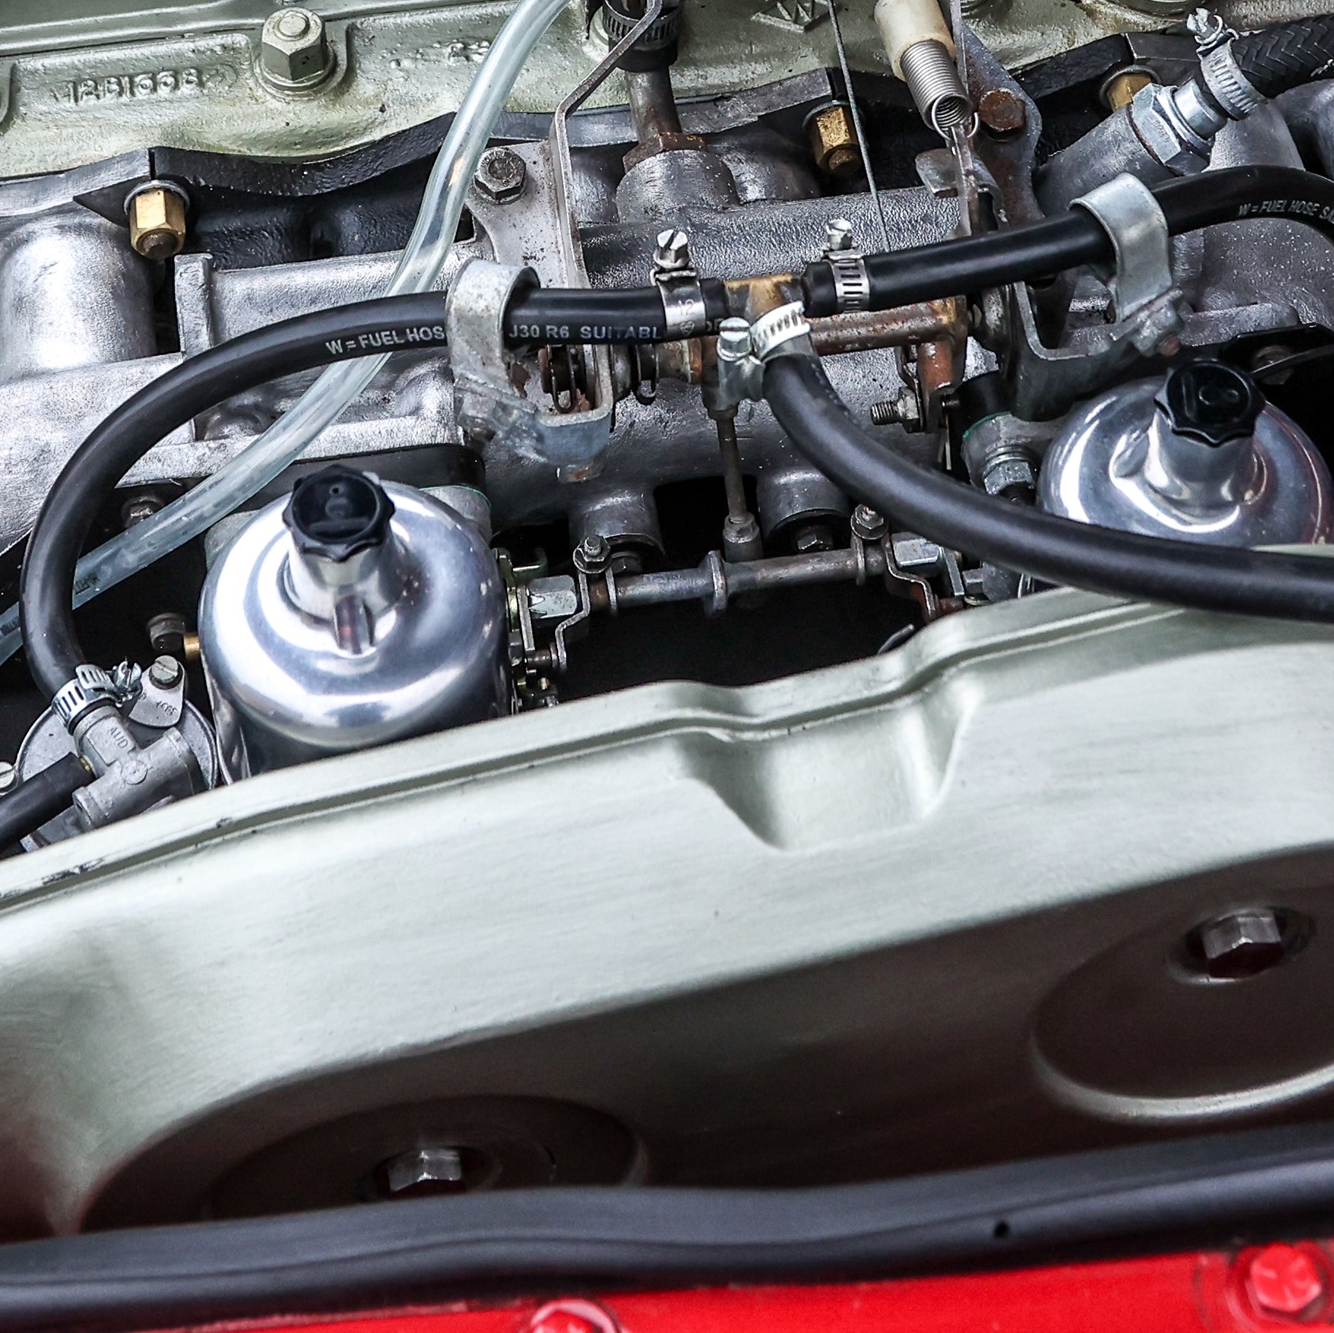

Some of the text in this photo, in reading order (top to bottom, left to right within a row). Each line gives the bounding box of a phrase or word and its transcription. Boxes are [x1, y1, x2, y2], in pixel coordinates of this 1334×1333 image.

[1238, 202, 1250, 216] W
[1259, 199, 1287, 214] FUEL
[1287, 200, 1319, 216] HOSE
[326, 341, 344, 356] W
[361, 327, 405, 349] FUEL
[405, 324, 447, 343] HOS
[508, 324, 541, 339] J30
[545, 325, 570, 339] R6
[579, 324, 664, 341] SUITABL
[107, 726, 130, 750] AUD
